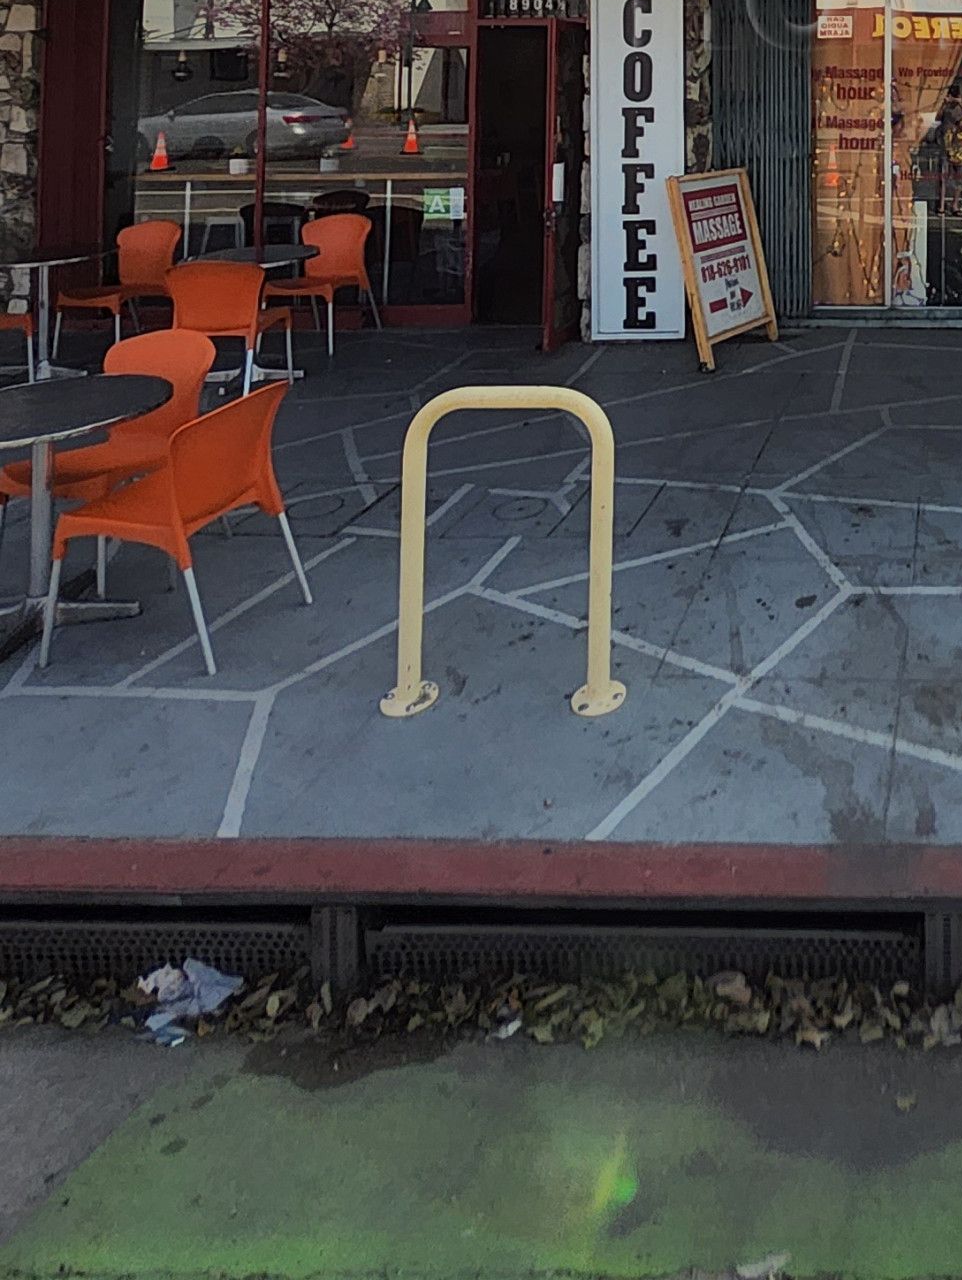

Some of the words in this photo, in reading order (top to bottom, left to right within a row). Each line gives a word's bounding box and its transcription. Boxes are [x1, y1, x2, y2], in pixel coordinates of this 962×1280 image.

[836, 83, 876, 100] hour
[838, 133, 877, 150] hour
[429, 195, 446, 213] A
[691, 212, 743, 246] MASSAGE
